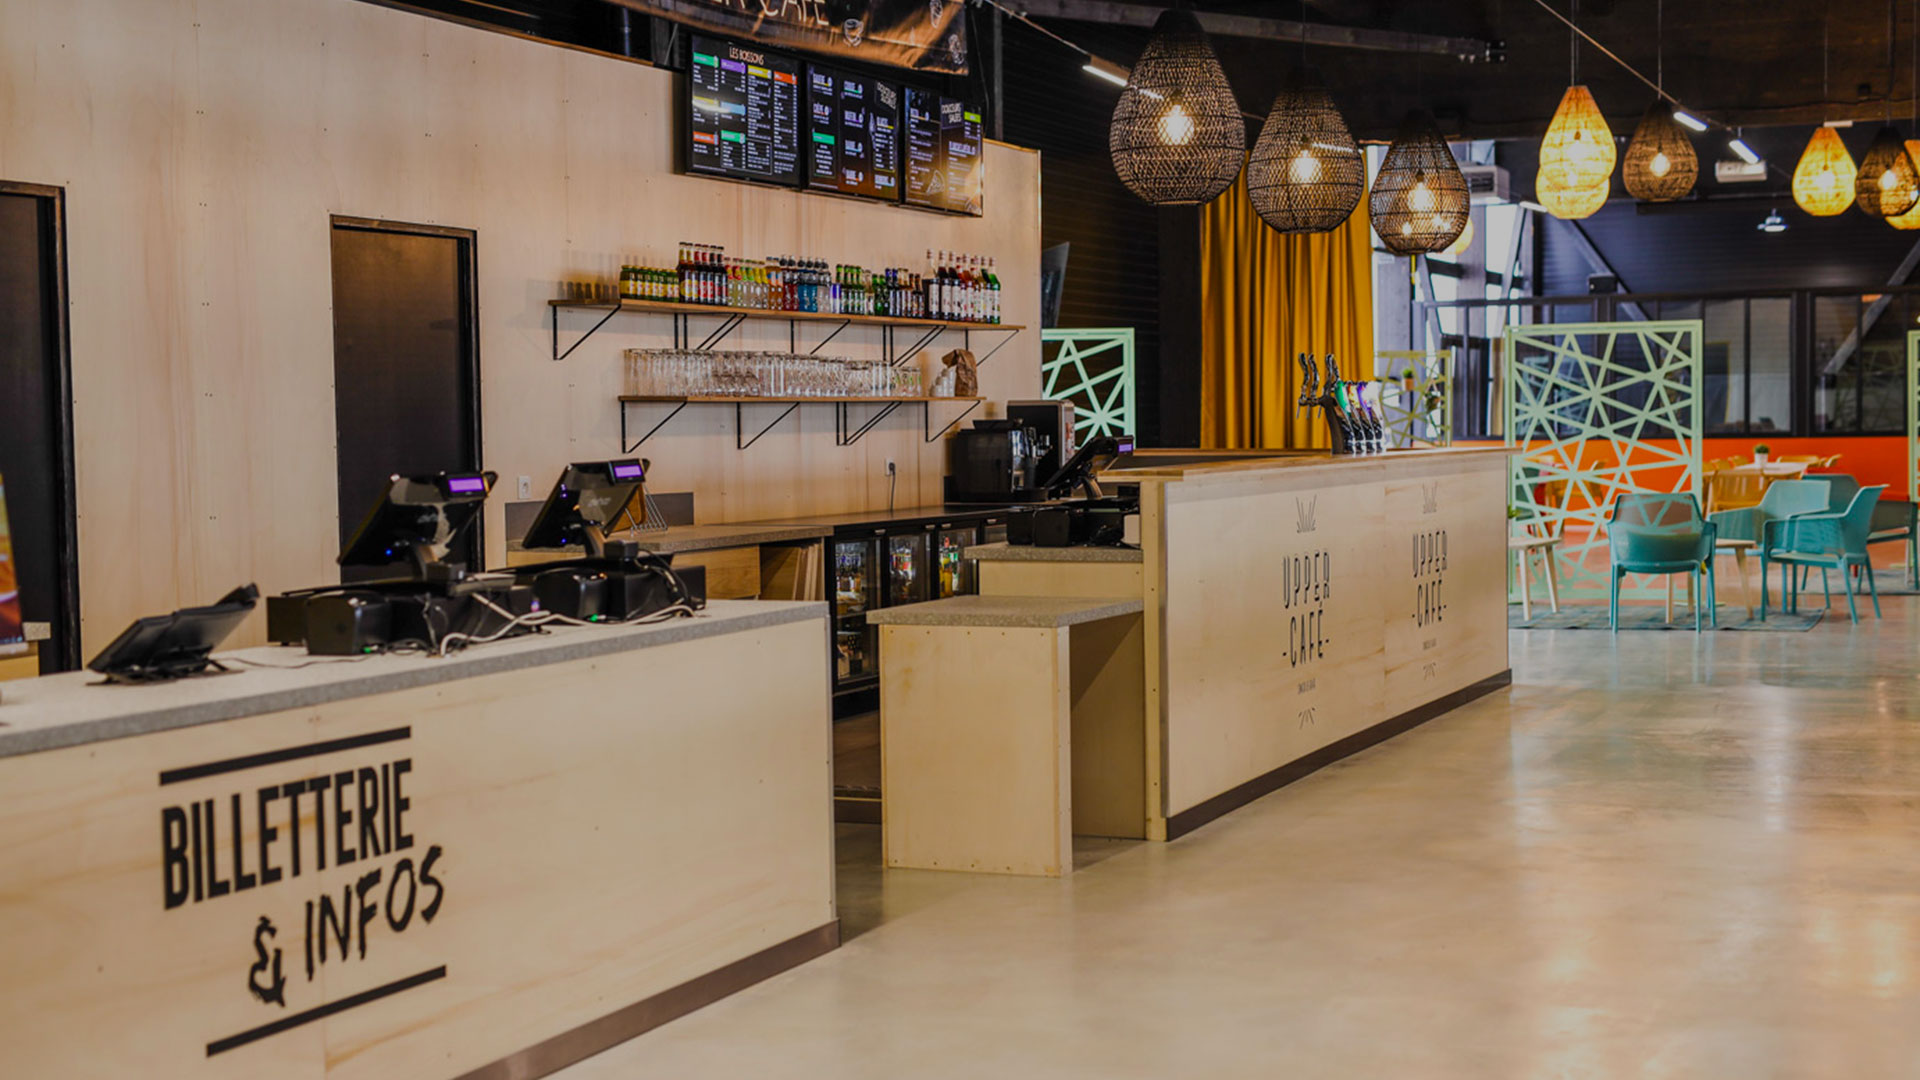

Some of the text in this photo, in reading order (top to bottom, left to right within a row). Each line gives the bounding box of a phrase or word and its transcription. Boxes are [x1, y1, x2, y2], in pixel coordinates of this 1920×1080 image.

[1283, 551, 1330, 609] UPPER
[1413, 530, 1447, 578] UPPER
[161, 758, 414, 911] BILLETTERIE
[248, 844, 445, 1008] & INFOS
